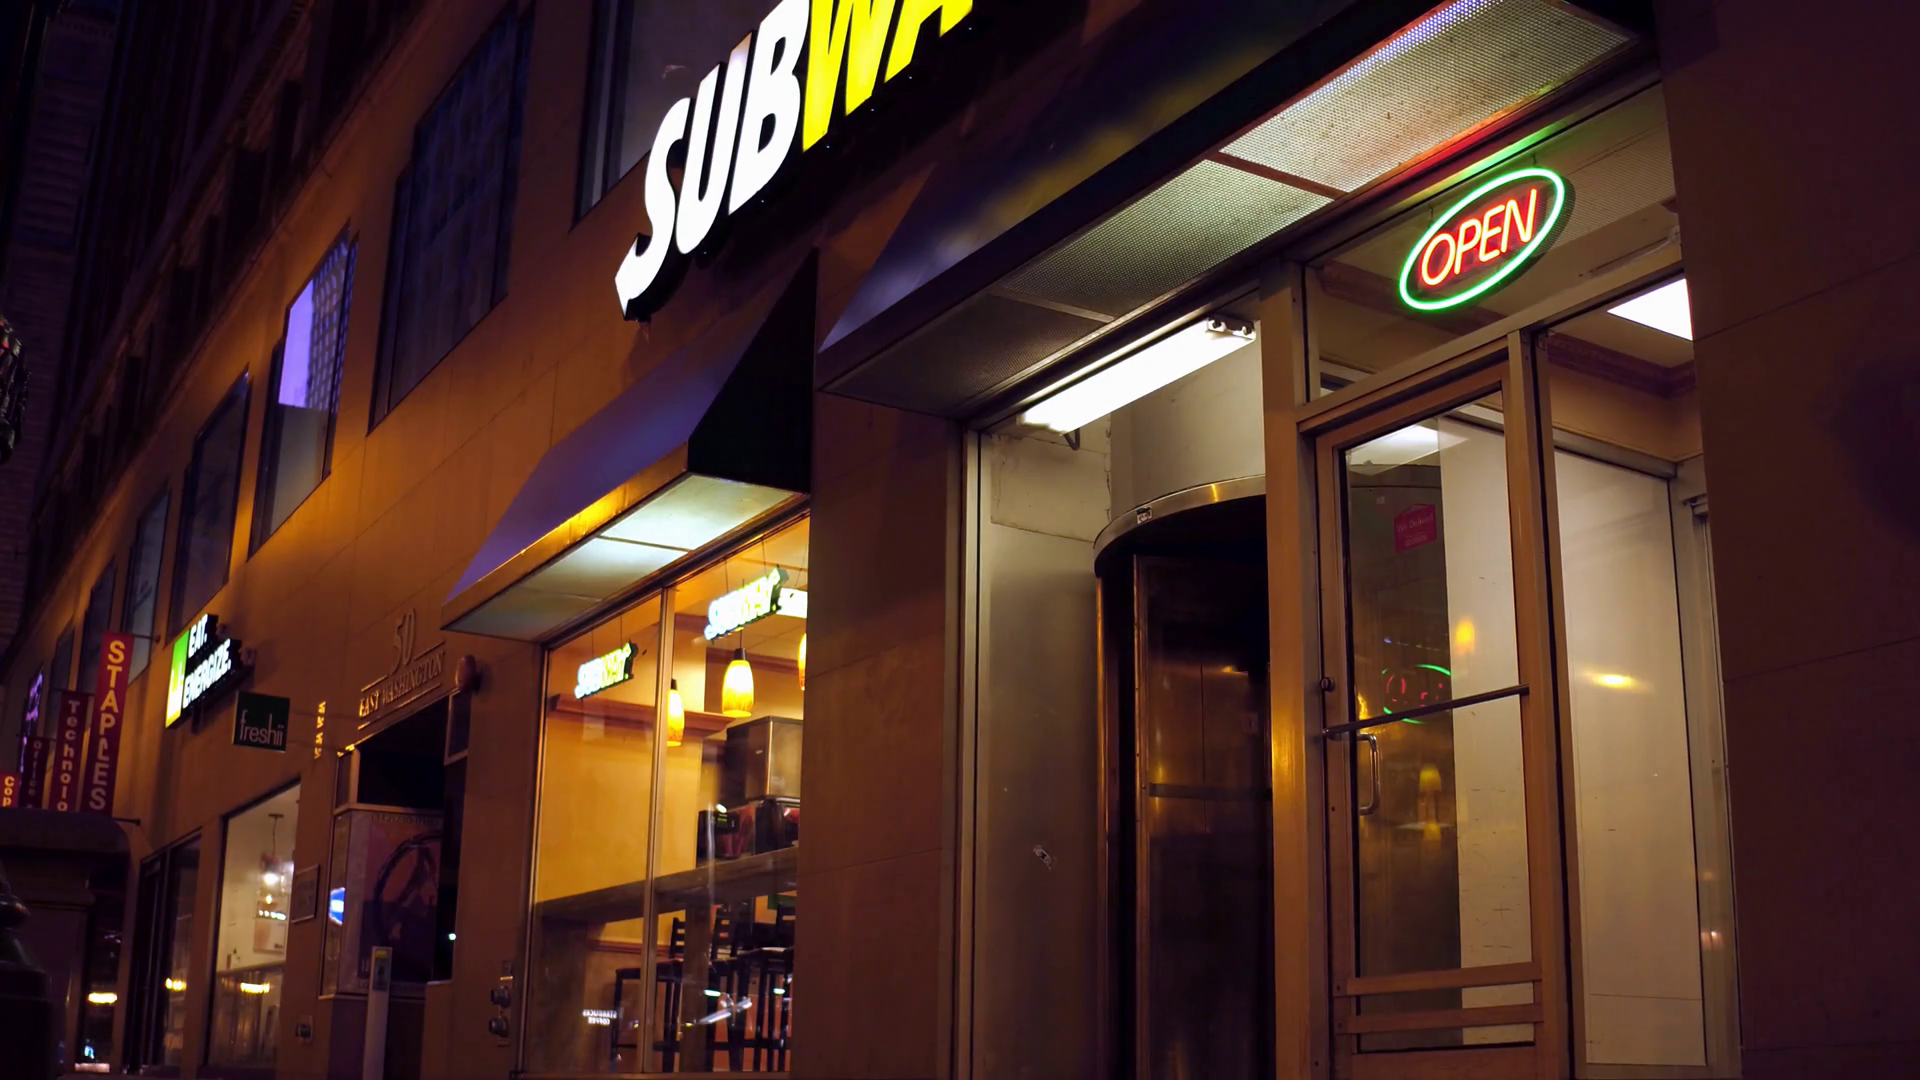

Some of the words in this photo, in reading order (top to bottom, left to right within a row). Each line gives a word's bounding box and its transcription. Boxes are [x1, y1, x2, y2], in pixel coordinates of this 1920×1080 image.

[1421, 187, 1537, 286] OPEN
[389, 607, 417, 676] 50
[358, 688, 381, 719] EAST
[382, 651, 446, 705] WASHINGTON
[89, 639, 126, 811] STAPLES
[239, 708, 285, 746] freshii
